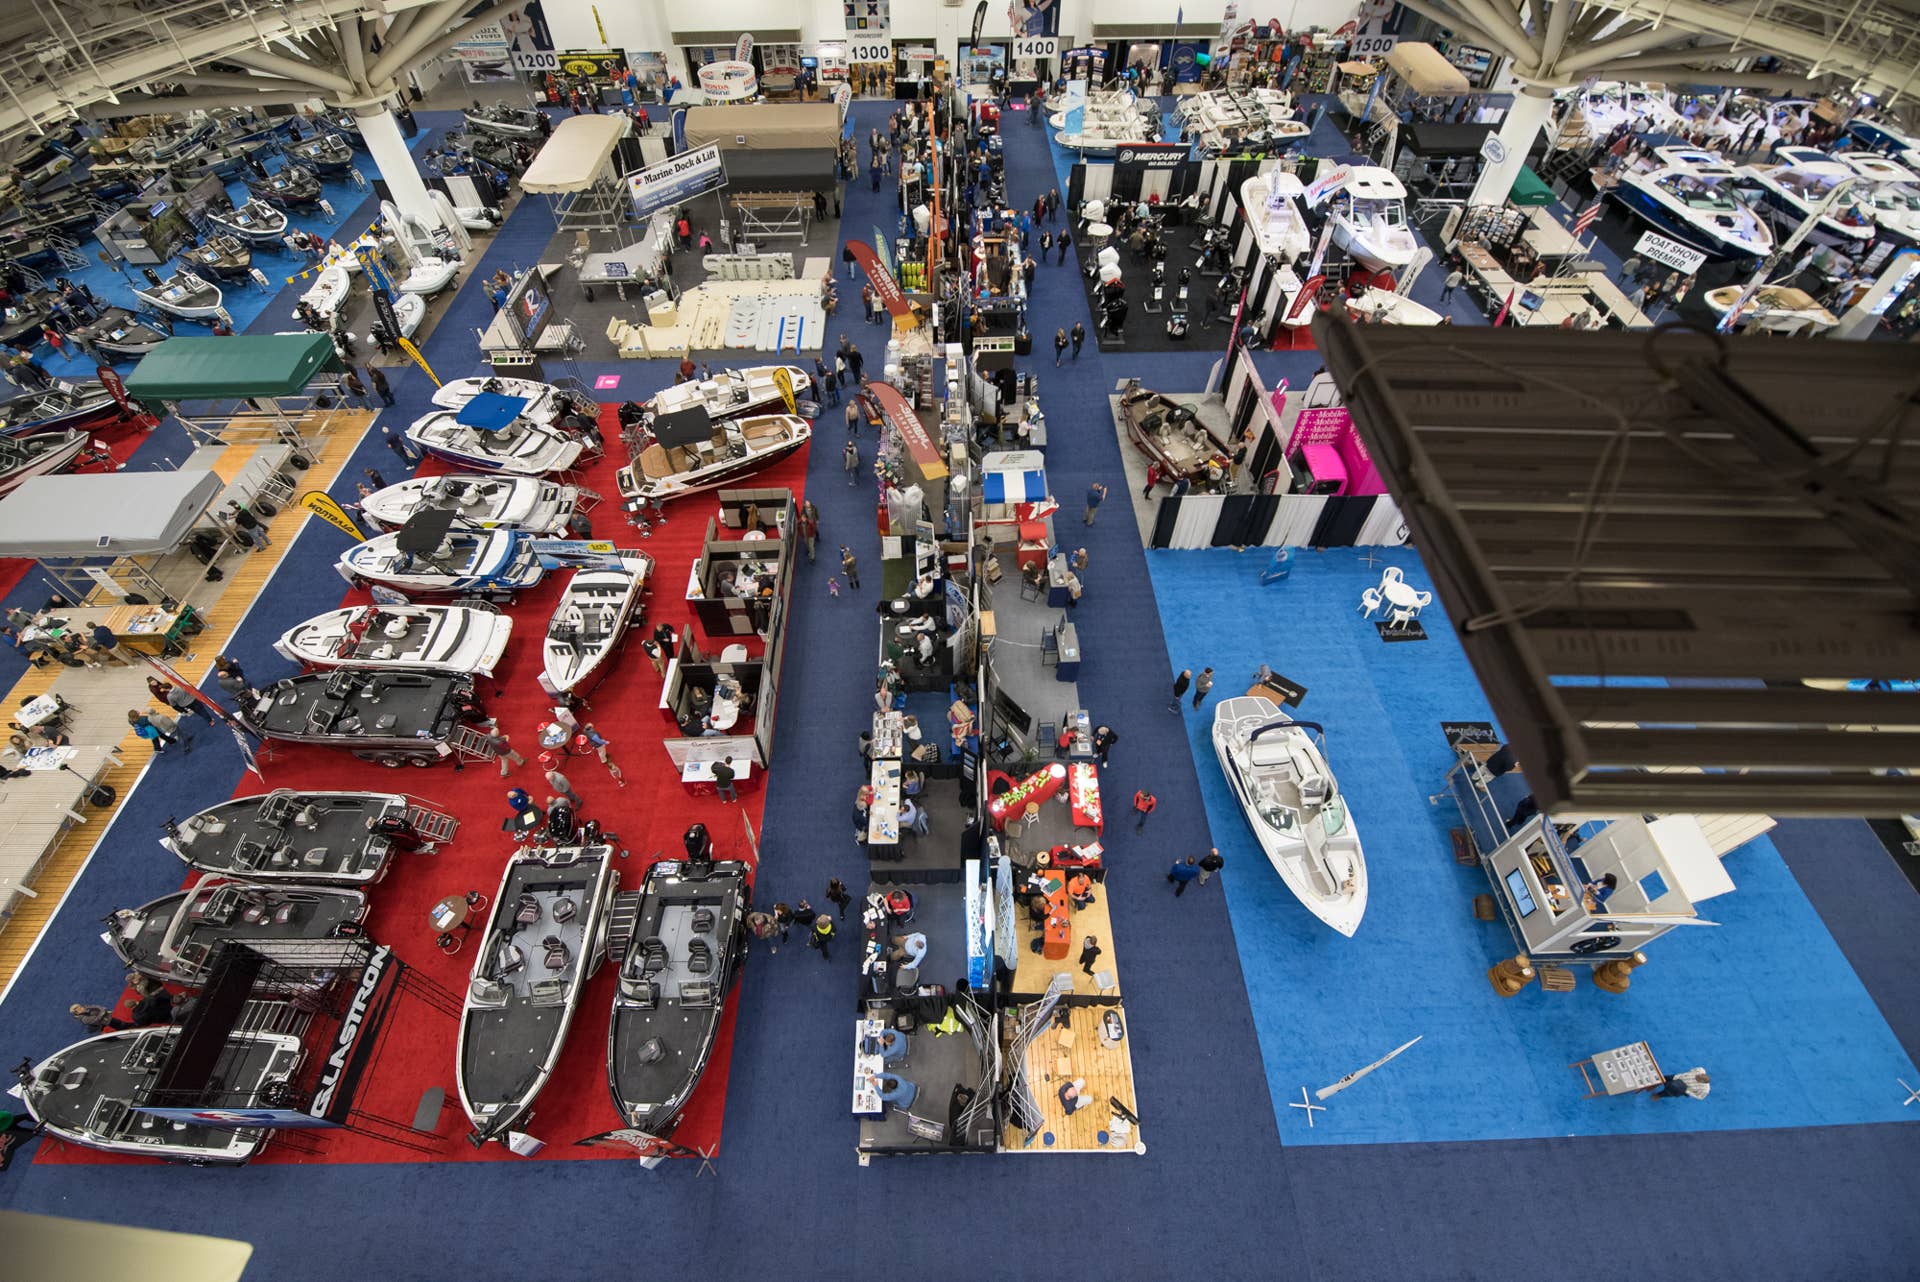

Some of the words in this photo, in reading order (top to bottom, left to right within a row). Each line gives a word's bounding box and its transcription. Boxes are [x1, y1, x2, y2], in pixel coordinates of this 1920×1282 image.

[852, 46, 889, 59] 1300
[1017, 41, 1055, 55] 1400
[1355, 39, 1393, 52] 1500
[517, 54, 556, 67] 1200
[1134, 152, 1185, 161] MERCURY
[643, 168, 674, 185] Marine
[674, 158, 695, 173] Dock
[695, 155, 702, 164] &
[702, 149, 716, 163] Lift
[1644, 234, 1671, 249] BOAT
[1670, 245, 1702, 262] SHOW
[1646, 246, 1686, 269] PREMIER
[310, 944, 391, 1119] GLASTRON
